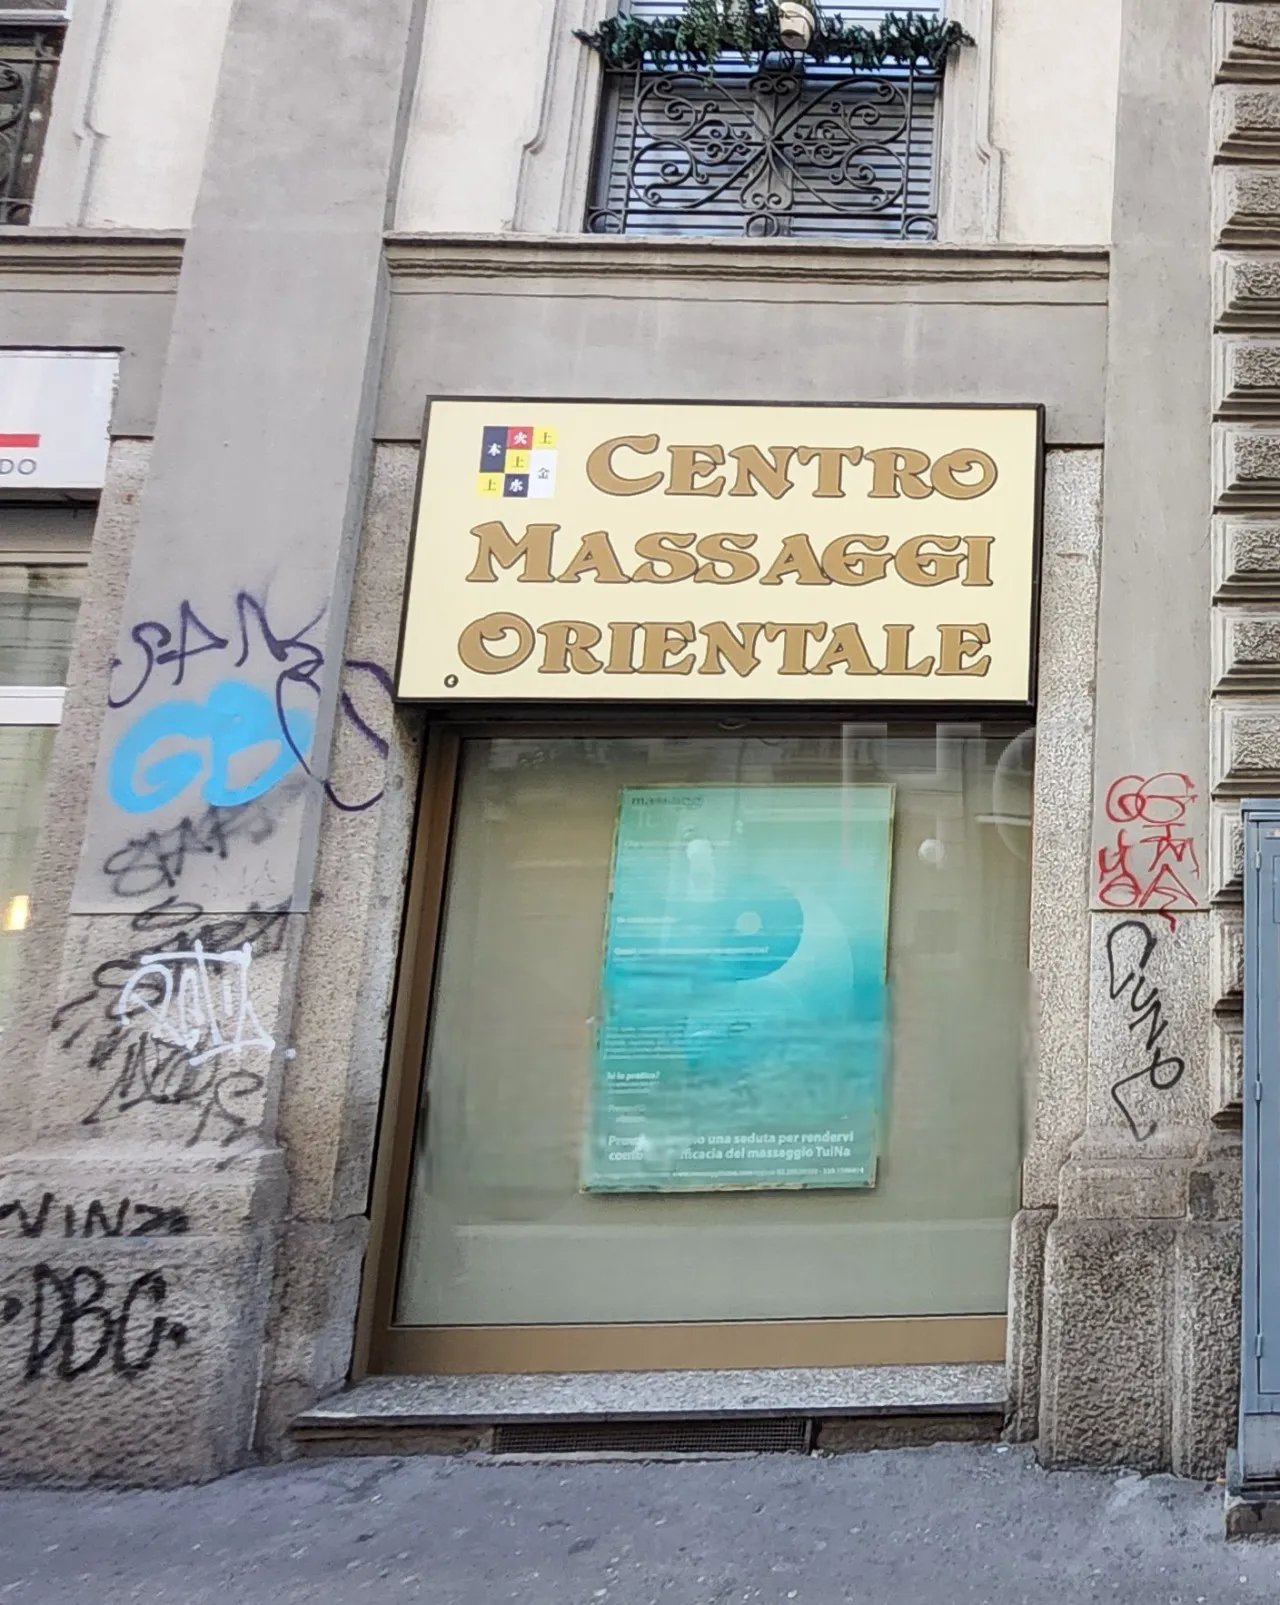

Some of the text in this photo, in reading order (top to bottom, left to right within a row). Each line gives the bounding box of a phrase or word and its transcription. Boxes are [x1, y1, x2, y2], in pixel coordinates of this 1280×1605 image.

[586, 433, 998, 500] CENTRO
[465, 520, 996, 587] MASSAGGI
[458, 611, 992, 677] ORIENTALE
[707, 1134, 732, 1146] una
[778, 1133, 800, 1145] per
[801, 1130, 854, 1143] rendervi
[725, 1147, 745, 1159] del
[747, 1146, 814, 1161] massaggio
